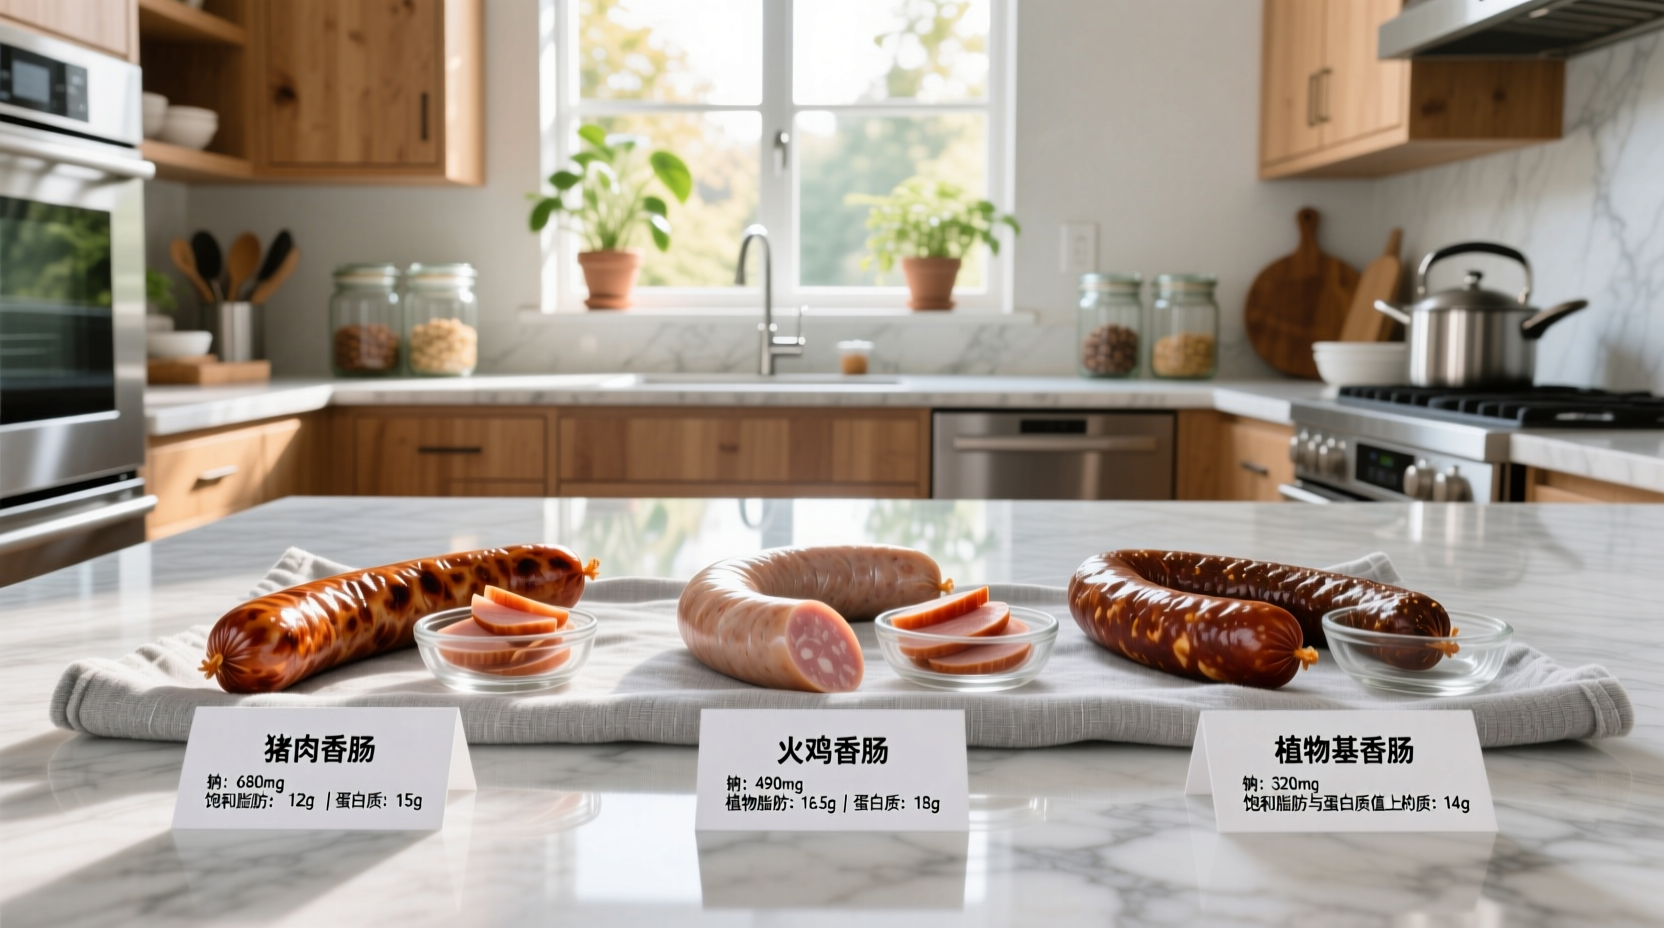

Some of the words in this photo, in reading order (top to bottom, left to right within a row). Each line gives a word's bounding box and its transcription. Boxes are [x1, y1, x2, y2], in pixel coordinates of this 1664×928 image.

[265, 734, 375, 763] 猪肉香肠
[778, 735, 888, 765] 火鸡香肠
[1275, 735, 1413, 764] 植物基香肠
[237, 775, 284, 793] 680mg
[755, 776, 803, 794] 490mg
[289, 793, 314, 810] 12g
[397, 793, 422, 810] 15g
[915, 796, 940, 813] 18g
[1444, 796, 1469, 813] 14g
